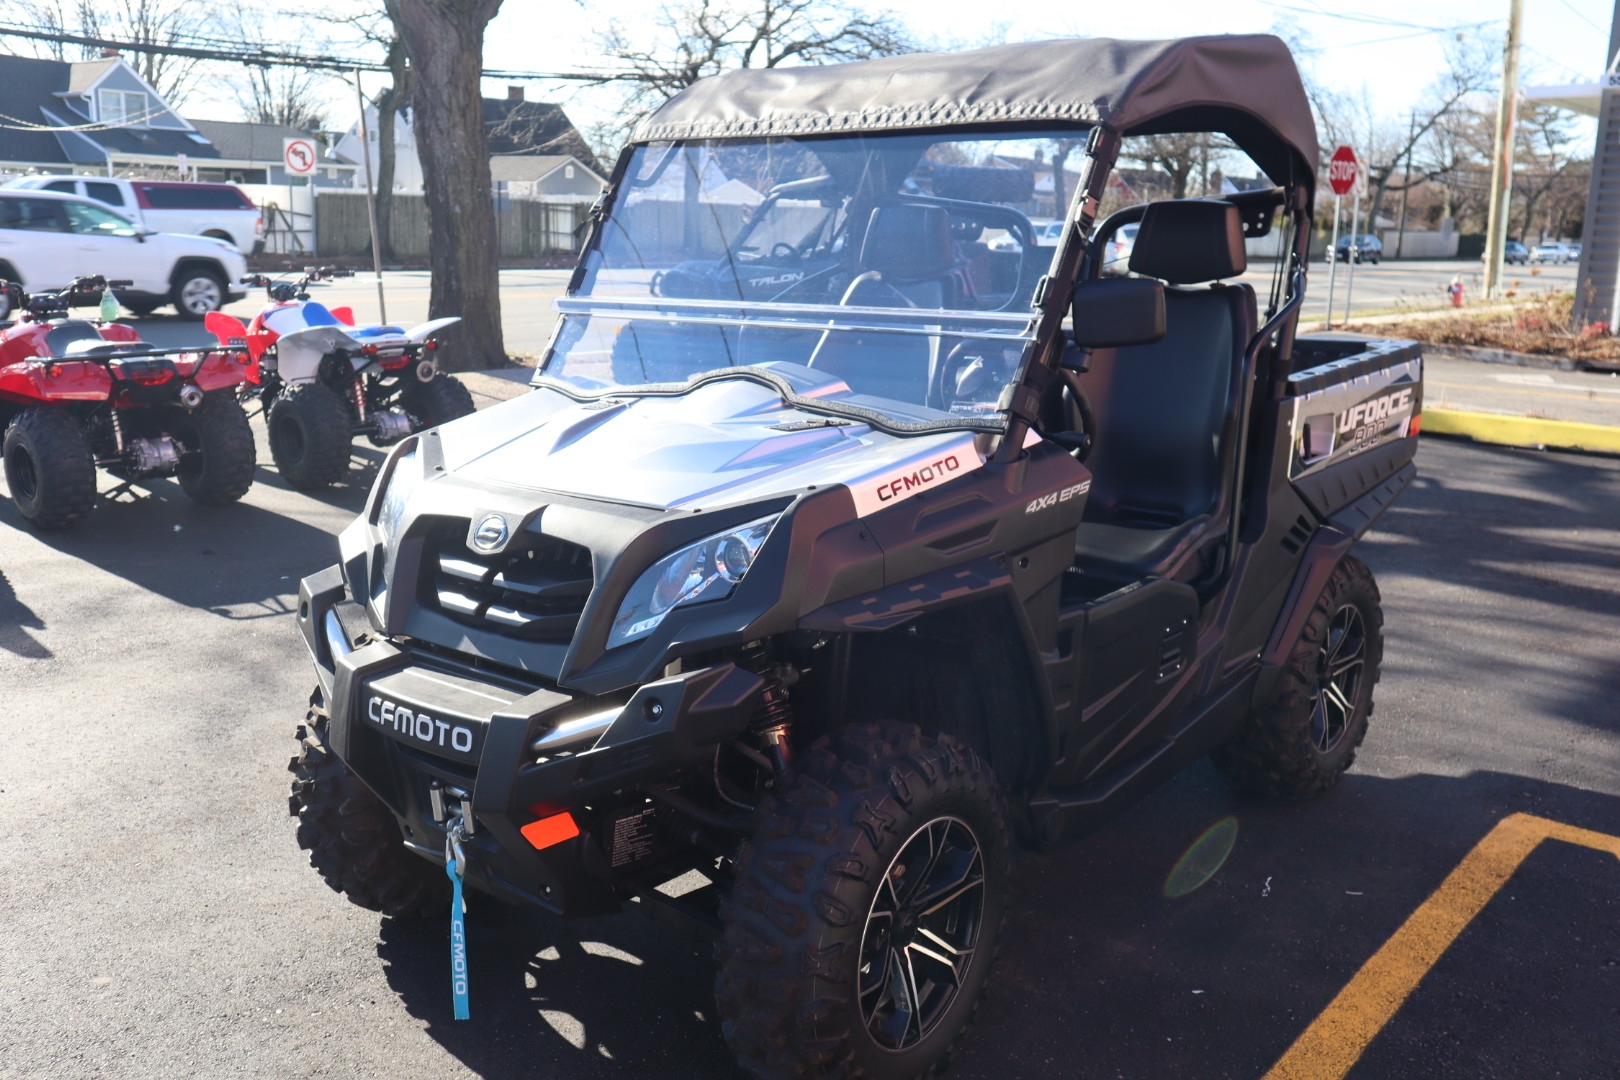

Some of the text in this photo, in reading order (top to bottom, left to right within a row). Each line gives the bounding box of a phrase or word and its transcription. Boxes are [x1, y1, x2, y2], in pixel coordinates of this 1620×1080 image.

[1330, 160, 1357, 180] STOP
[749, 271, 804, 287] TALON
[1340, 388, 1412, 434] UFORCE
[877, 455, 960, 502] CFMOTO
[1059, 479, 1092, 503] EPS
[368, 696, 474, 753] CFMOTO
[453, 919, 467, 996] CFMOTO
